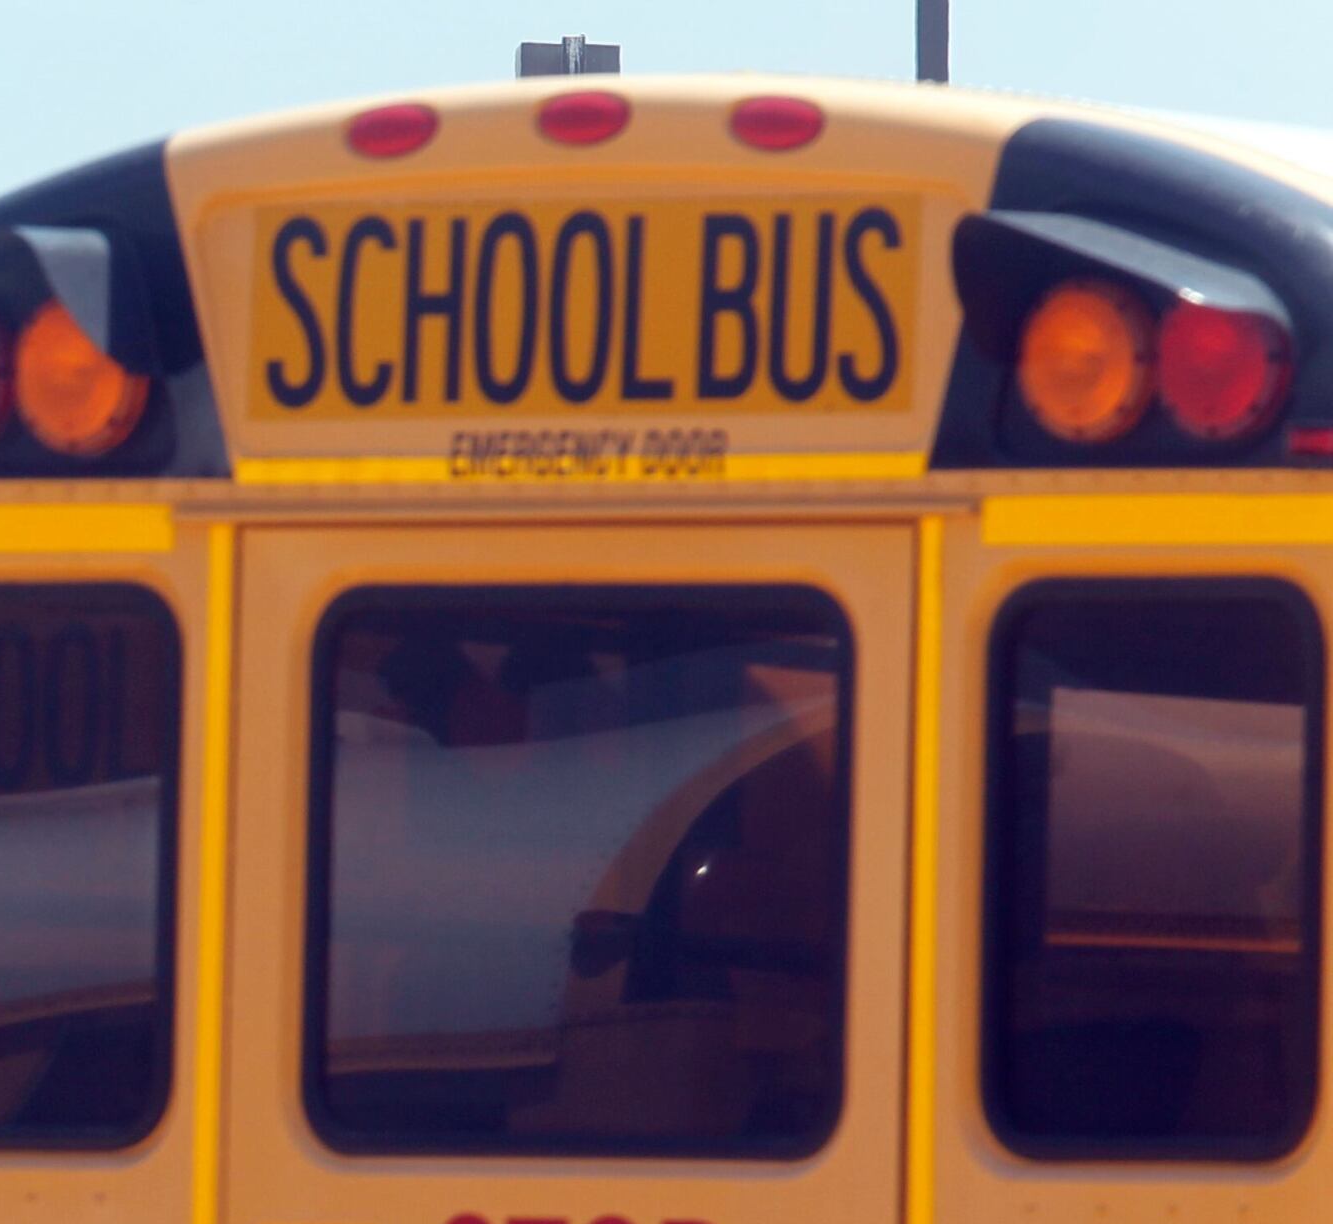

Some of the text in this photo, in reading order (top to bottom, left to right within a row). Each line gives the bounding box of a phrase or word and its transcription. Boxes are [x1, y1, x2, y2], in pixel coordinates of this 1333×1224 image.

[264, 205, 904, 409] SCHOOL BUS
[449, 428, 730, 477] EMERGENCY DOOR
